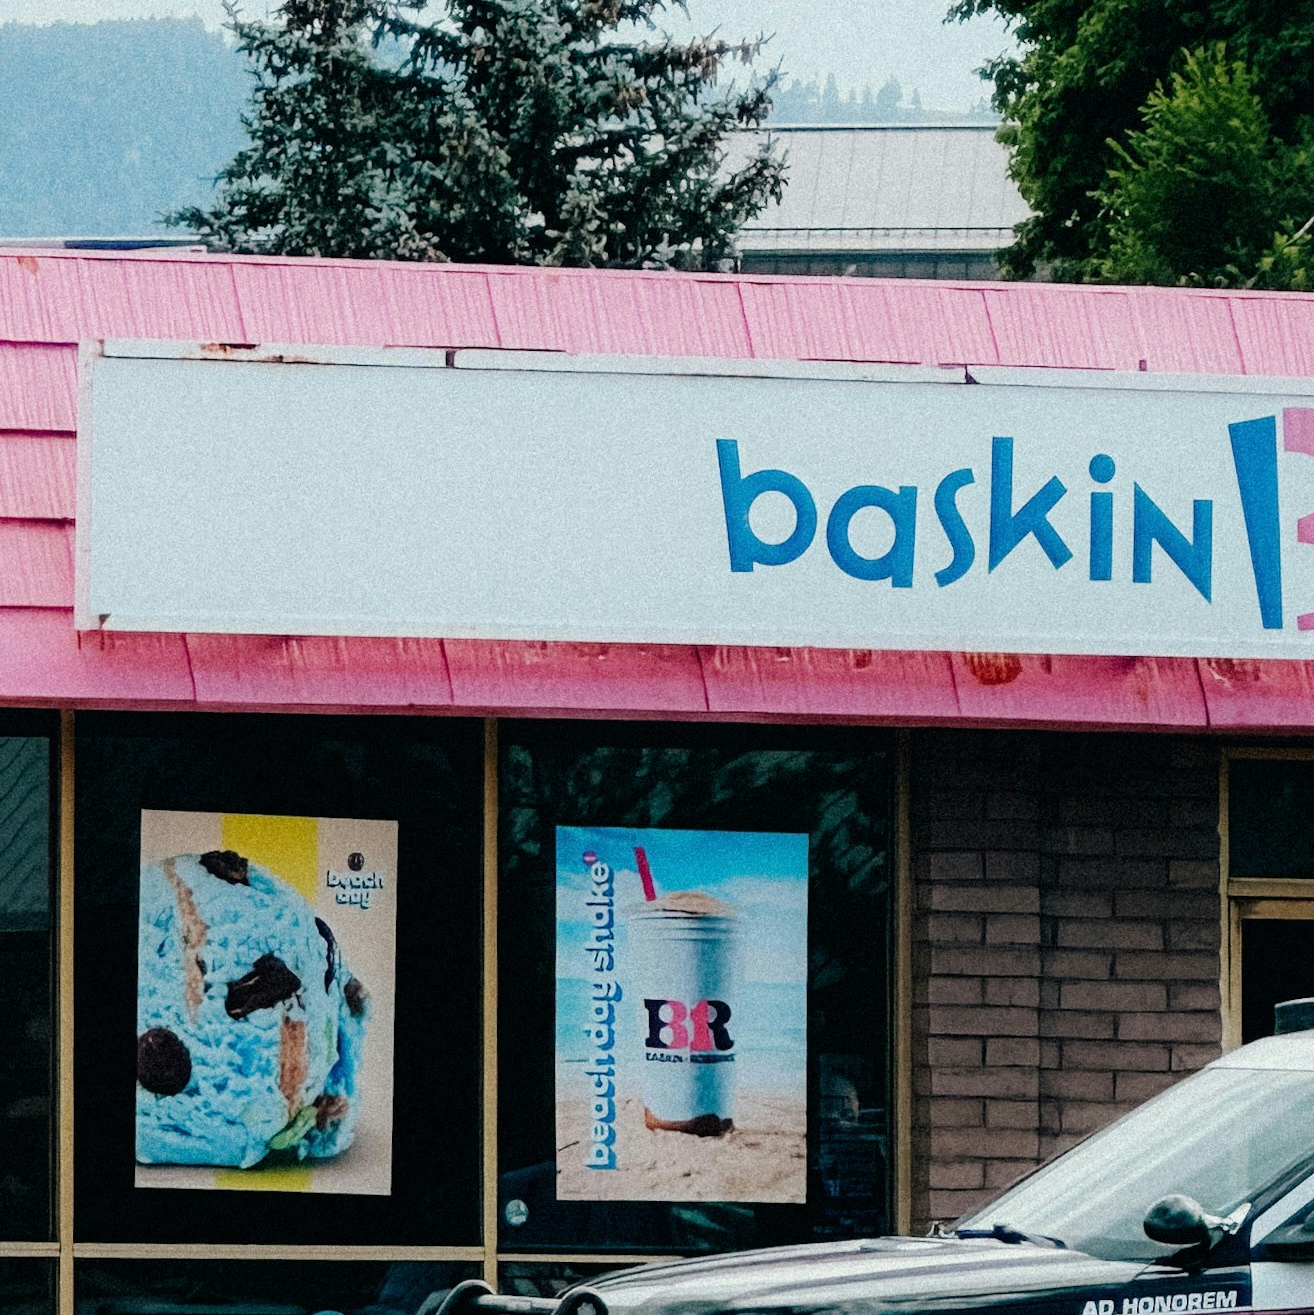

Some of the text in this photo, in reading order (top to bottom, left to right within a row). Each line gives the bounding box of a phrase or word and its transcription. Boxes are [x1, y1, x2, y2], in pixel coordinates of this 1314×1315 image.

[716, 436, 1213, 605] baskin
[582, 860, 622, 1171] beach day shake
[644, 998, 735, 1052] BR
[1121, 1289, 1238, 1315] HONOREM
